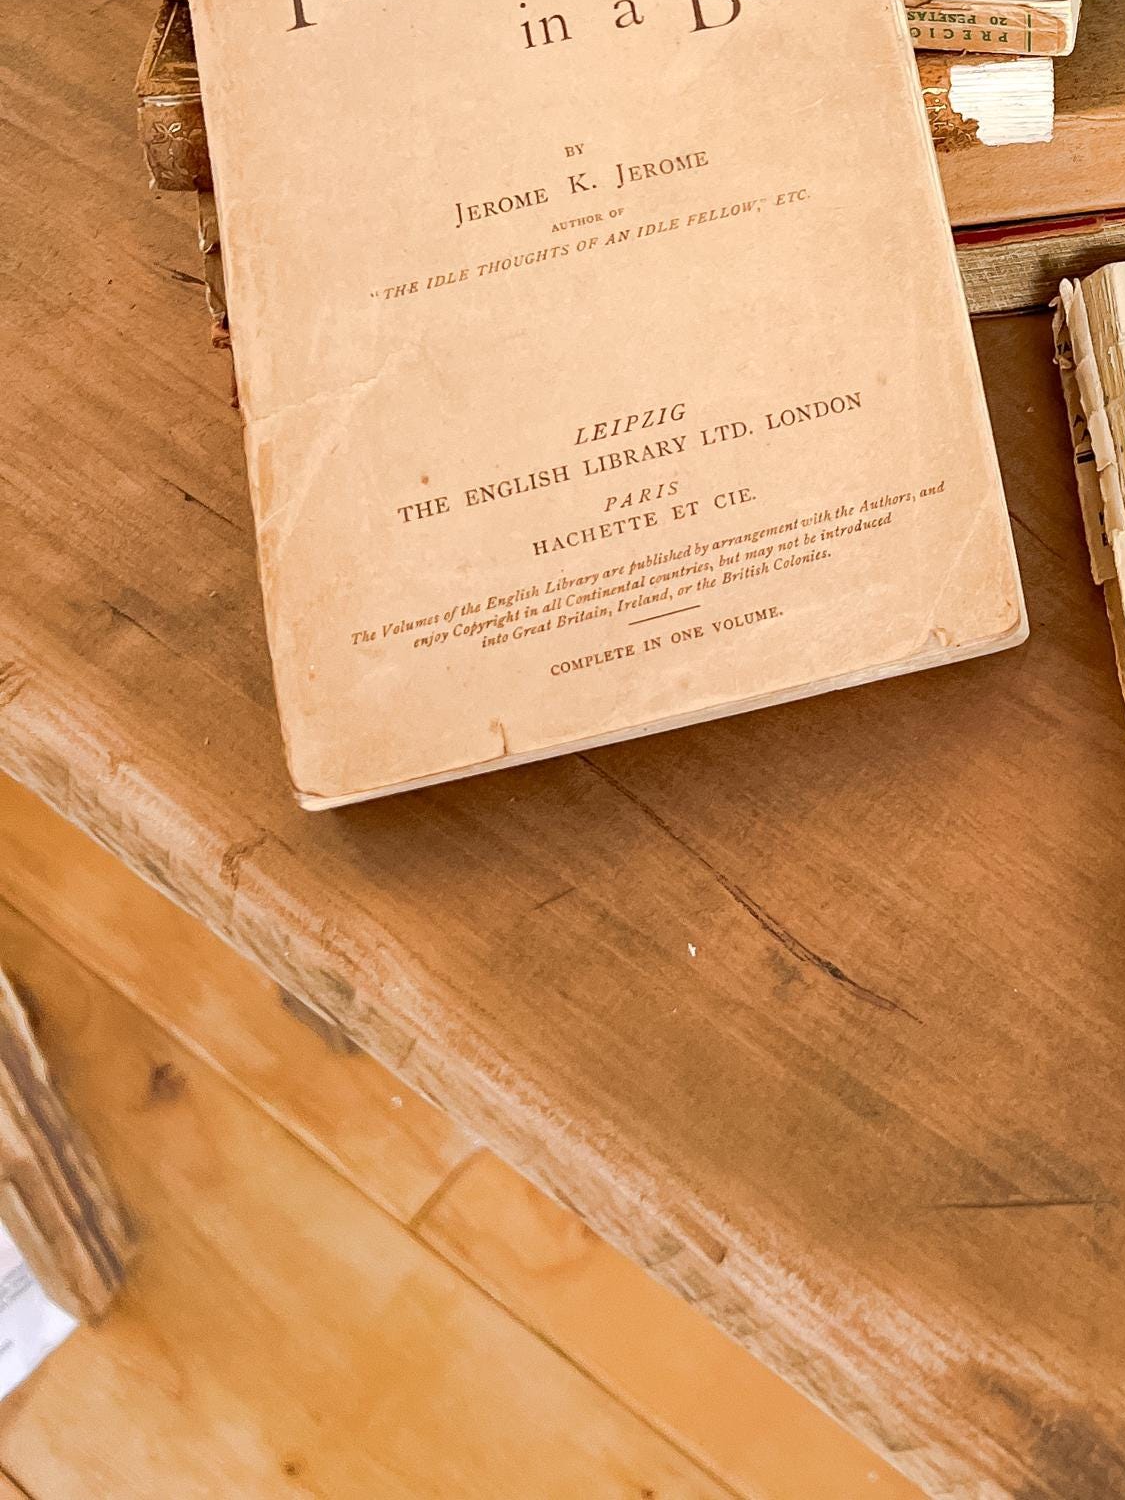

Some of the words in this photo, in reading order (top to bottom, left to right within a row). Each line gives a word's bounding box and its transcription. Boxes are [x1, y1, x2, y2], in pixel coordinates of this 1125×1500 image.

[519, 2, 572, 49] in
[907, 11, 976, 24] PESETAS
[990, 17, 1007, 26] 20
[564, 143, 585, 159] BY
[455, 188, 549, 228] JEROME
[568, 174, 597, 194] K.
[615, 151, 709, 189] JEROME
[551, 212, 604, 233] AUTHOR
[609, 207, 625, 219] OF
[426, 268, 469, 291] IDLE
[477, 244, 570, 278] THOUGHTS
[576, 237, 599, 254] OF
[606, 228, 630, 247] AN
[637, 216, 680, 239] IDLE
[775, 189, 810, 207] ETC.
[398, 496, 451, 524] THE
[464, 466, 571, 508] ENGLISH
[582, 437, 688, 477] LIBRARY
[701, 423, 754, 449] LTD.
[765, 392, 863, 431] LONDON
[574, 403, 688, 446] LEIPZIG
[532, 511, 659, 557] HACHETTE
[671, 502, 699, 521] ET
[713, 488, 757, 509] CIE.
[604, 479, 681, 512] PARIS
[351, 628, 378, 646] The
[381, 614, 440, 638] Volumes
[444, 607, 457, 626] of
[460, 602, 482, 618] the
[486, 584, 540, 612] English
[544, 571, 599, 596] Library
[602, 565, 626, 580] are
[629, 544, 693, 574] published
[694, 541, 711, 556] by
[711, 519, 800, 551] arrangement
[801, 510, 832, 530] with
[834, 504, 855, 521] the
[859, 491, 918, 514] Authors,
[920, 481, 946, 497] and
[412, 629, 449, 649] enjoy
[452, 610, 522, 638] Copyright
[525, 604, 539, 618] in
[542, 598, 562, 615] all
[566, 577, 646, 608] Continental
[649, 563, 715, 588] countries,
[718, 552, 741, 568] but
[744, 547, 774, 564] may
[777, 537, 800, 553] not
[802, 531, 818, 548] be
[819, 513, 892, 543] introduced
[481, 631, 509, 649] into
[512, 621, 551, 641] Great
[556, 607, 612, 630] Britain,
[616, 591, 674, 614] Ireland,
[677, 585, 692, 598] or
[695, 576, 718, 593] the
[721, 563, 770, 586] British
[773, 549, 832, 572] Colonies.
[550, 644, 636, 676] COMPLETE
[644, 637, 662, 652] IN
[670, 625, 704, 646] ONE
[711, 608, 784, 633] VOLUME.
